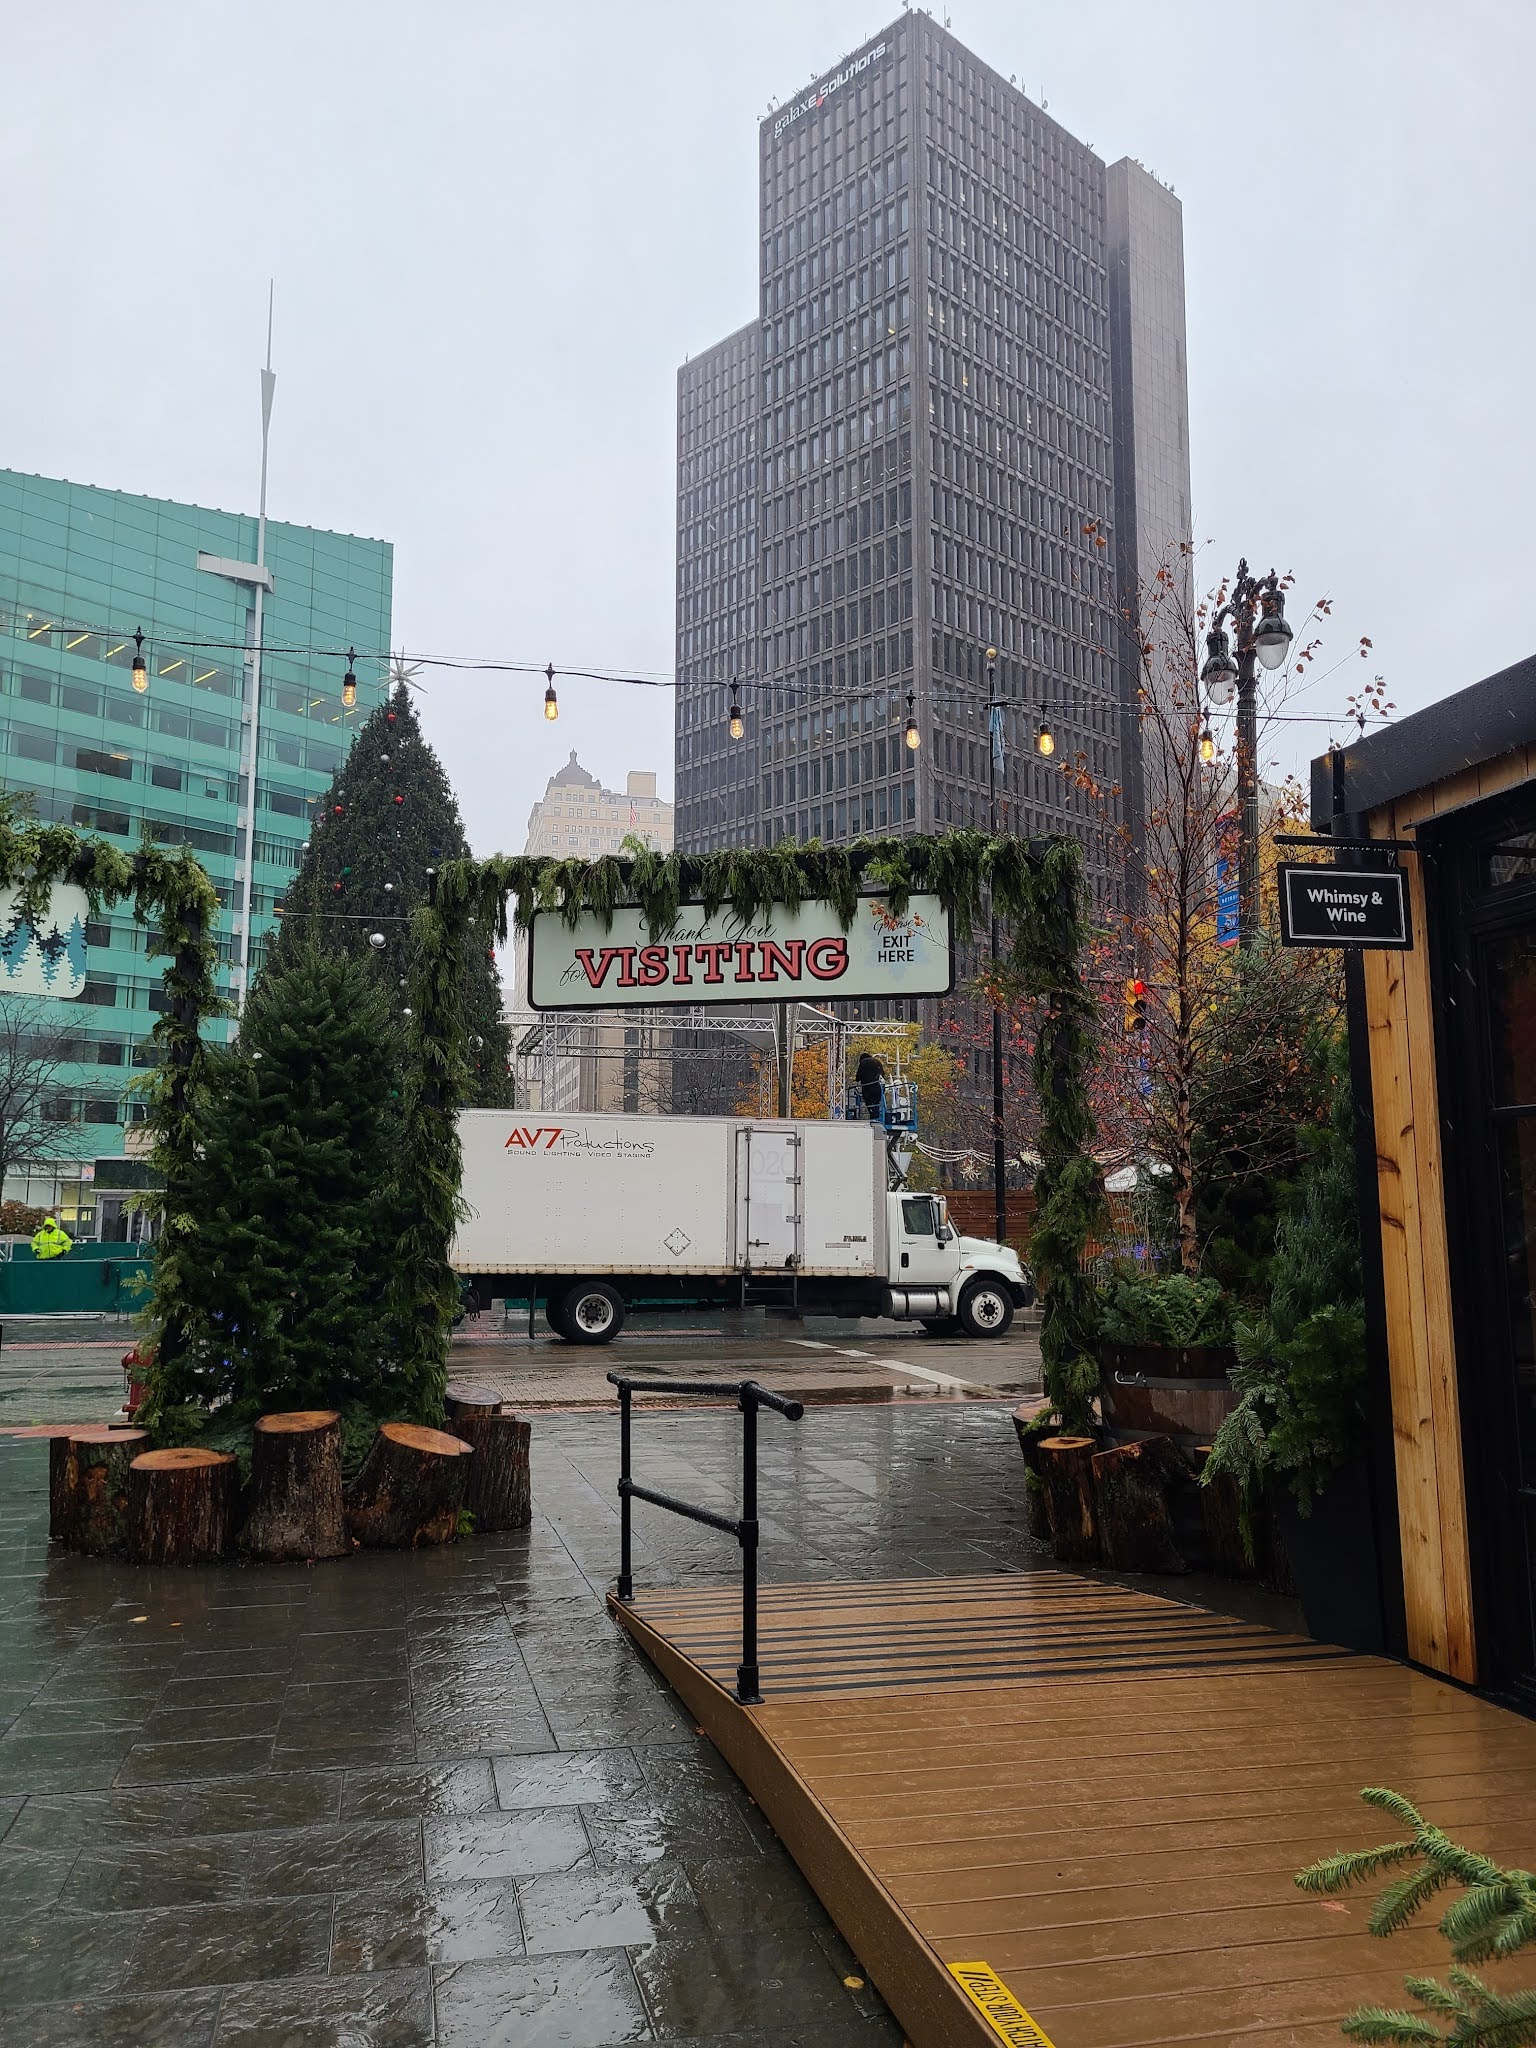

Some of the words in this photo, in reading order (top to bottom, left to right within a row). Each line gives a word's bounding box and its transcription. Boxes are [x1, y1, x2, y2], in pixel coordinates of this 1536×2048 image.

[1306, 888, 1369, 908] Whimsy
[1371, 891, 1384, 905] &
[1326, 907, 1367, 922] Wine
[716, 908, 778, 950] You
[883, 935, 911, 948] EXIT
[559, 960, 591, 986] for
[575, 936, 850, 988] VISITING
[878, 950, 914, 963] HERE
[504, 1127, 563, 1149] AV7
[559, 1127, 655, 1153] Productions
[968, 1981, 1009, 2002] STEP
[985, 2002, 1027, 2027] YOUR
[1002, 2025, 1048, 2048] ATCH
